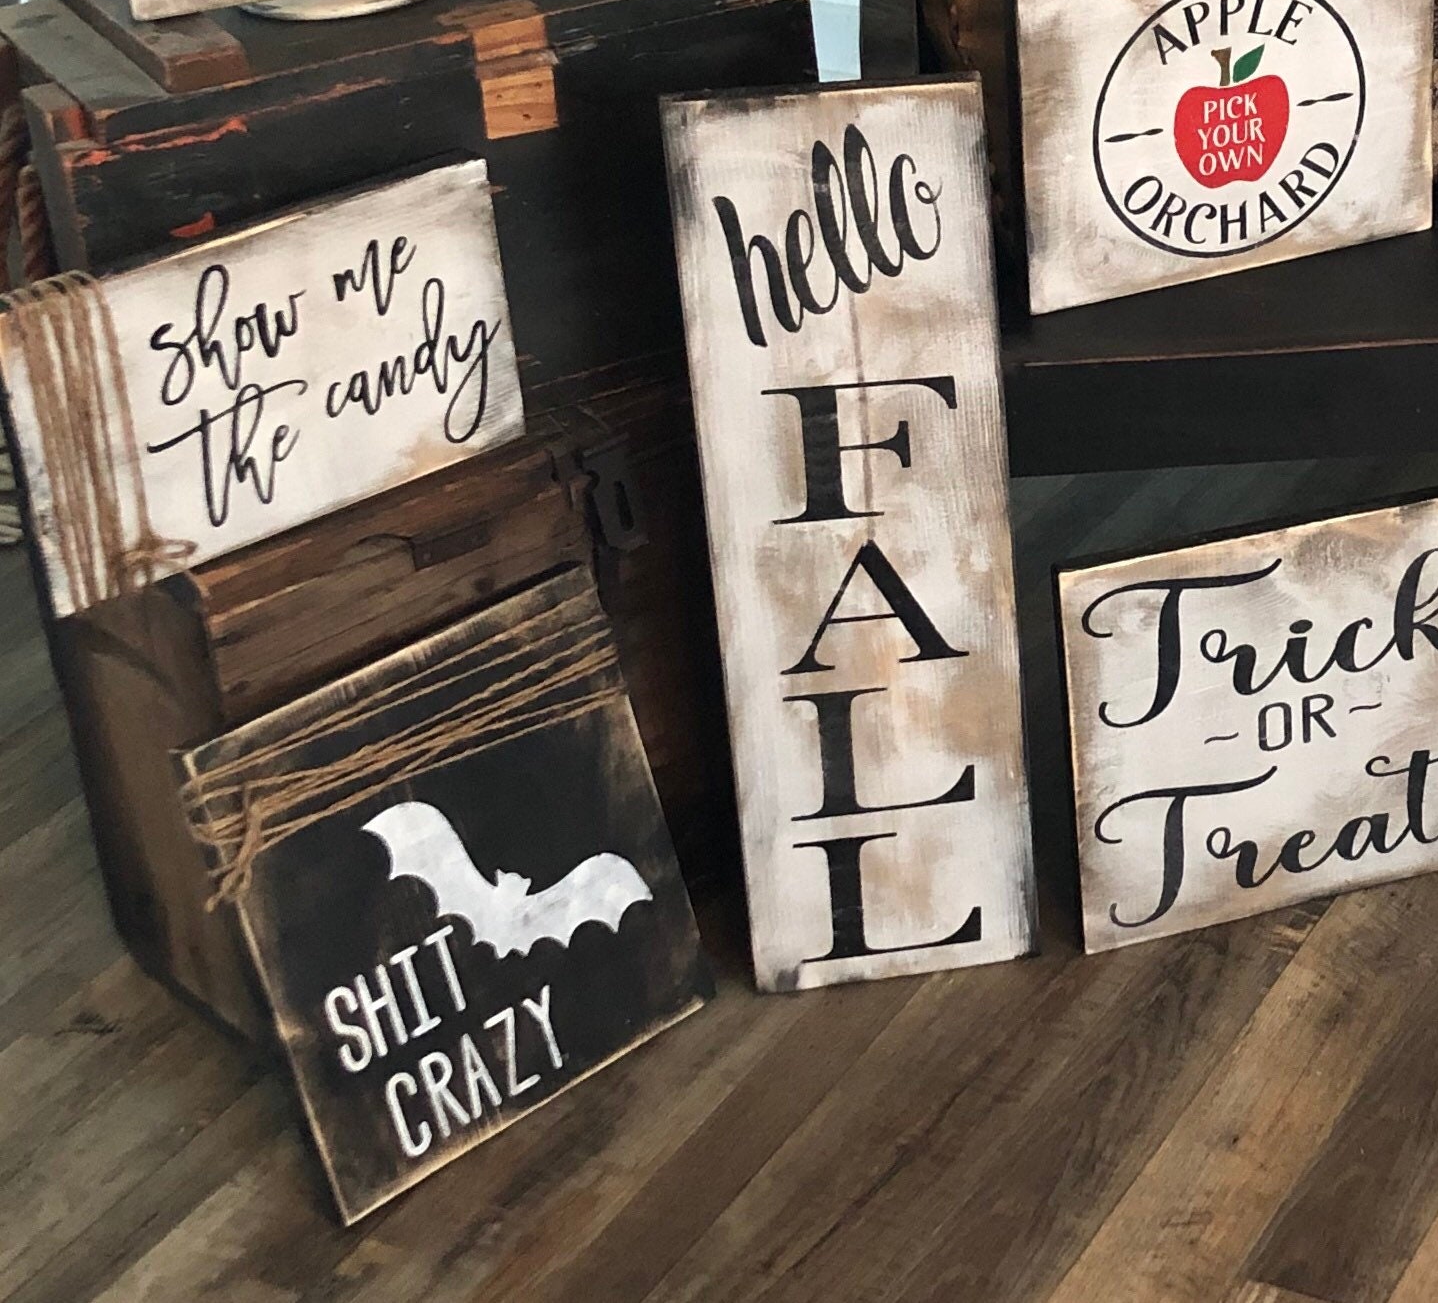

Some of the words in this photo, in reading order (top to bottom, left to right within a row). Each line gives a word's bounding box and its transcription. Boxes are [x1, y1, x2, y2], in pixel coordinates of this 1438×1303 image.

[1198, 117, 1266, 151] YOUR
[1199, 142, 1264, 177] OWN
[1203, 93, 1258, 124] PICK
[714, 122, 944, 349] hello
[1124, 141, 1340, 245] ORCHARD
[149, 264, 305, 405] show
[332, 235, 416, 316] me
[147, 379, 306, 527] the
[326, 278, 501, 444] candy
[760, 375, 984, 965] FALL
[324, 925, 467, 1073] SHIT
[385, 985, 564, 1158] CRAZY
